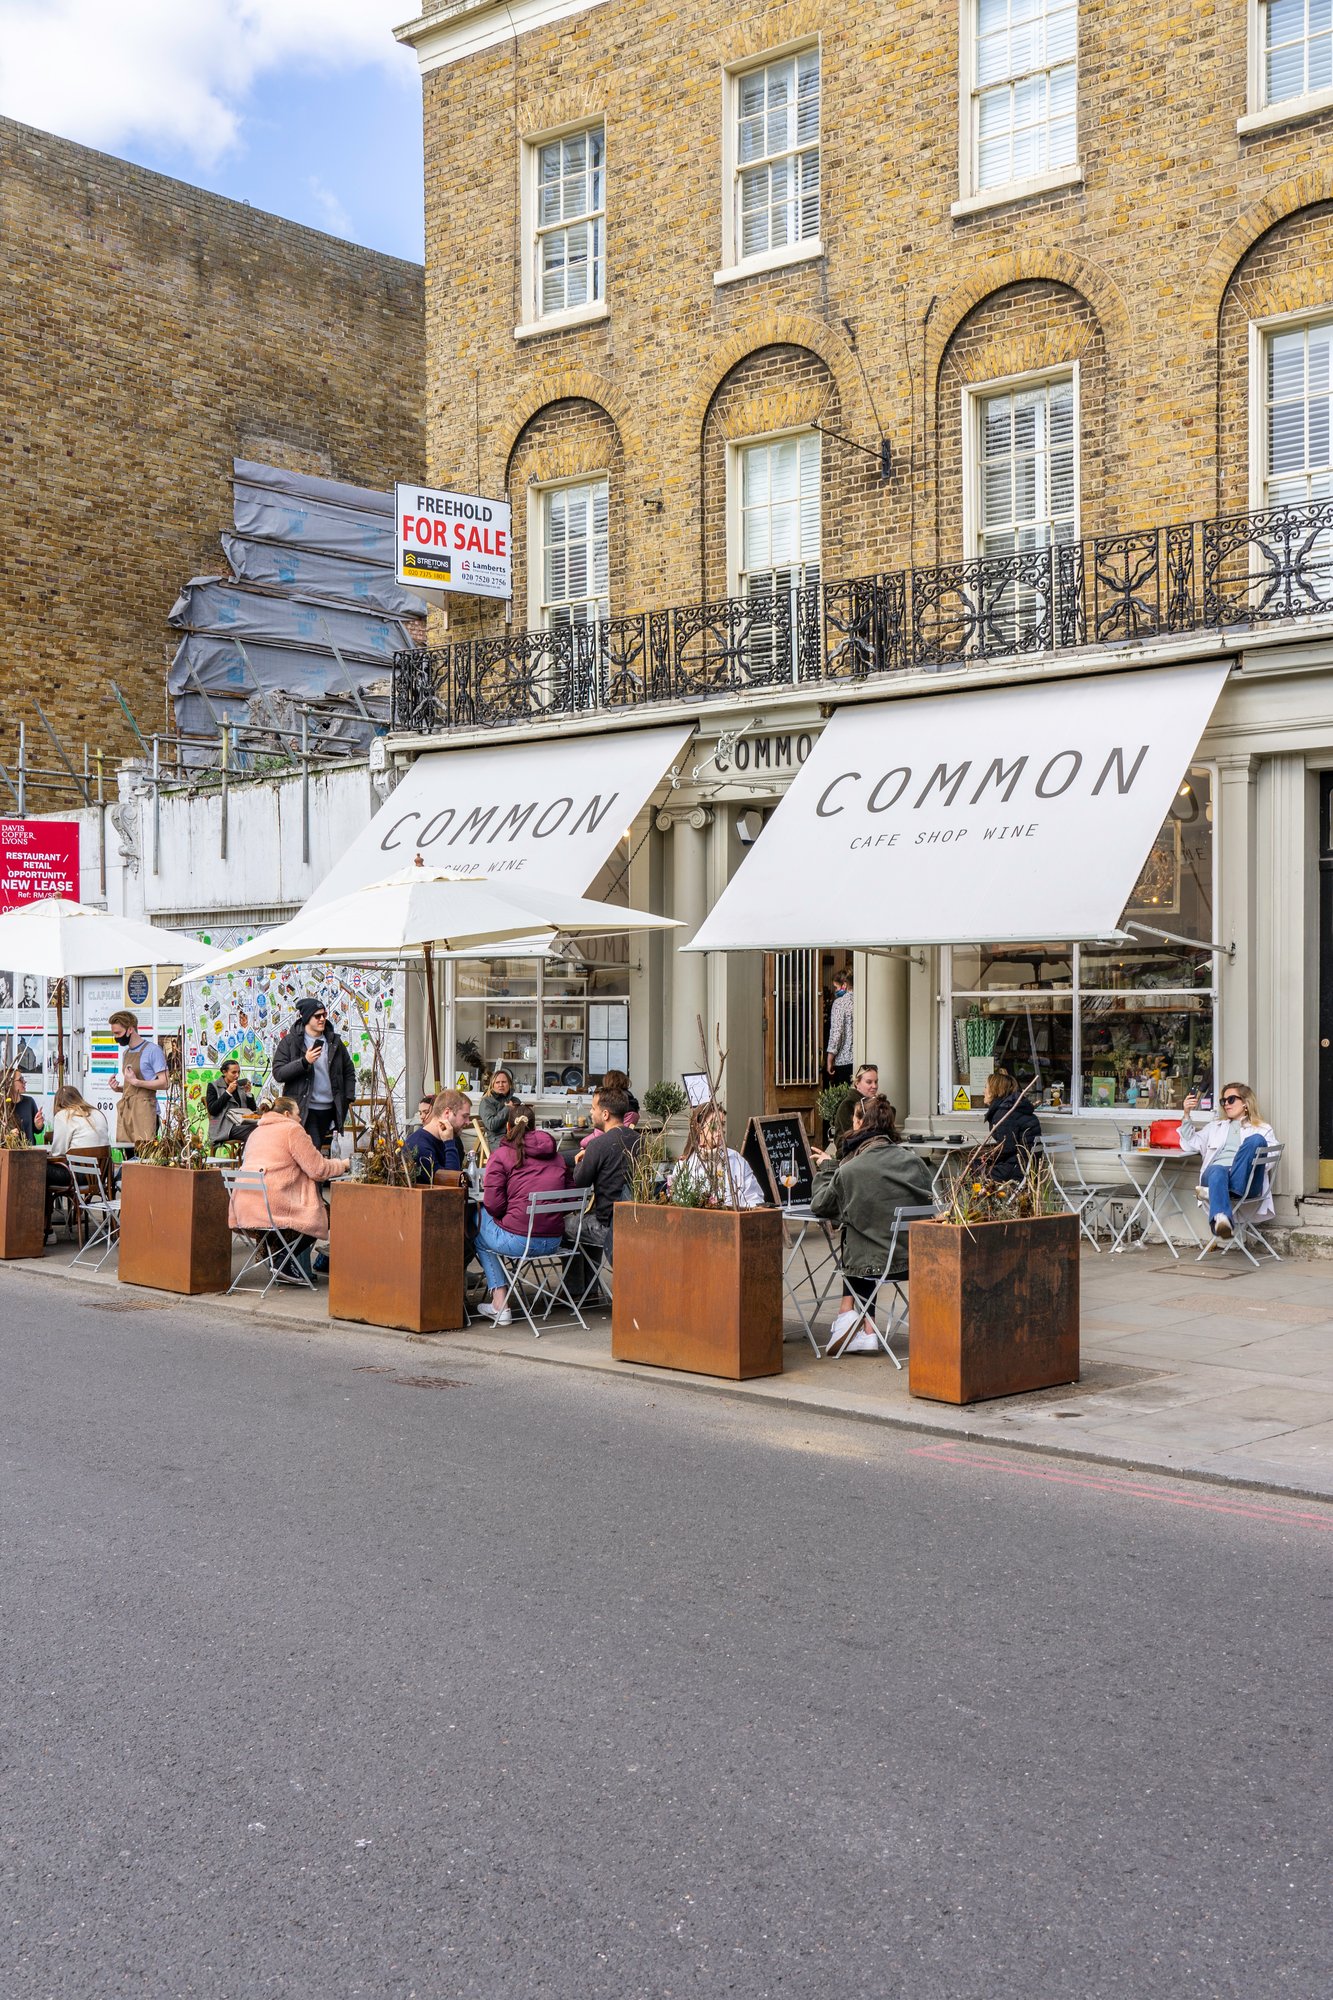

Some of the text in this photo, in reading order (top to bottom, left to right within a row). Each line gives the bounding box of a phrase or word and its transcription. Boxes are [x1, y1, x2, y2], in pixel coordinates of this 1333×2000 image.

[417, 495, 492, 522] FREEHOLD
[403, 515, 506, 557] FOR SALE
[417, 557, 449, 567] STRETTONS
[473, 561, 506, 572] Lamberts
[475, 574, 490, 583] 7520
[816, 745, 1149, 817] COMMON
[380, 792, 619, 851] COMMON
[2, 832, 37, 840] COFFER
[850, 823, 1039, 850] CAFE SHOP WINE
[6, 852, 61, 861] RESTAURANT
[488, 859, 527, 872] WINE
[8, 870, 67, 879] OPPORTUNITY
[1, 879, 73, 891] NEW LEASE
